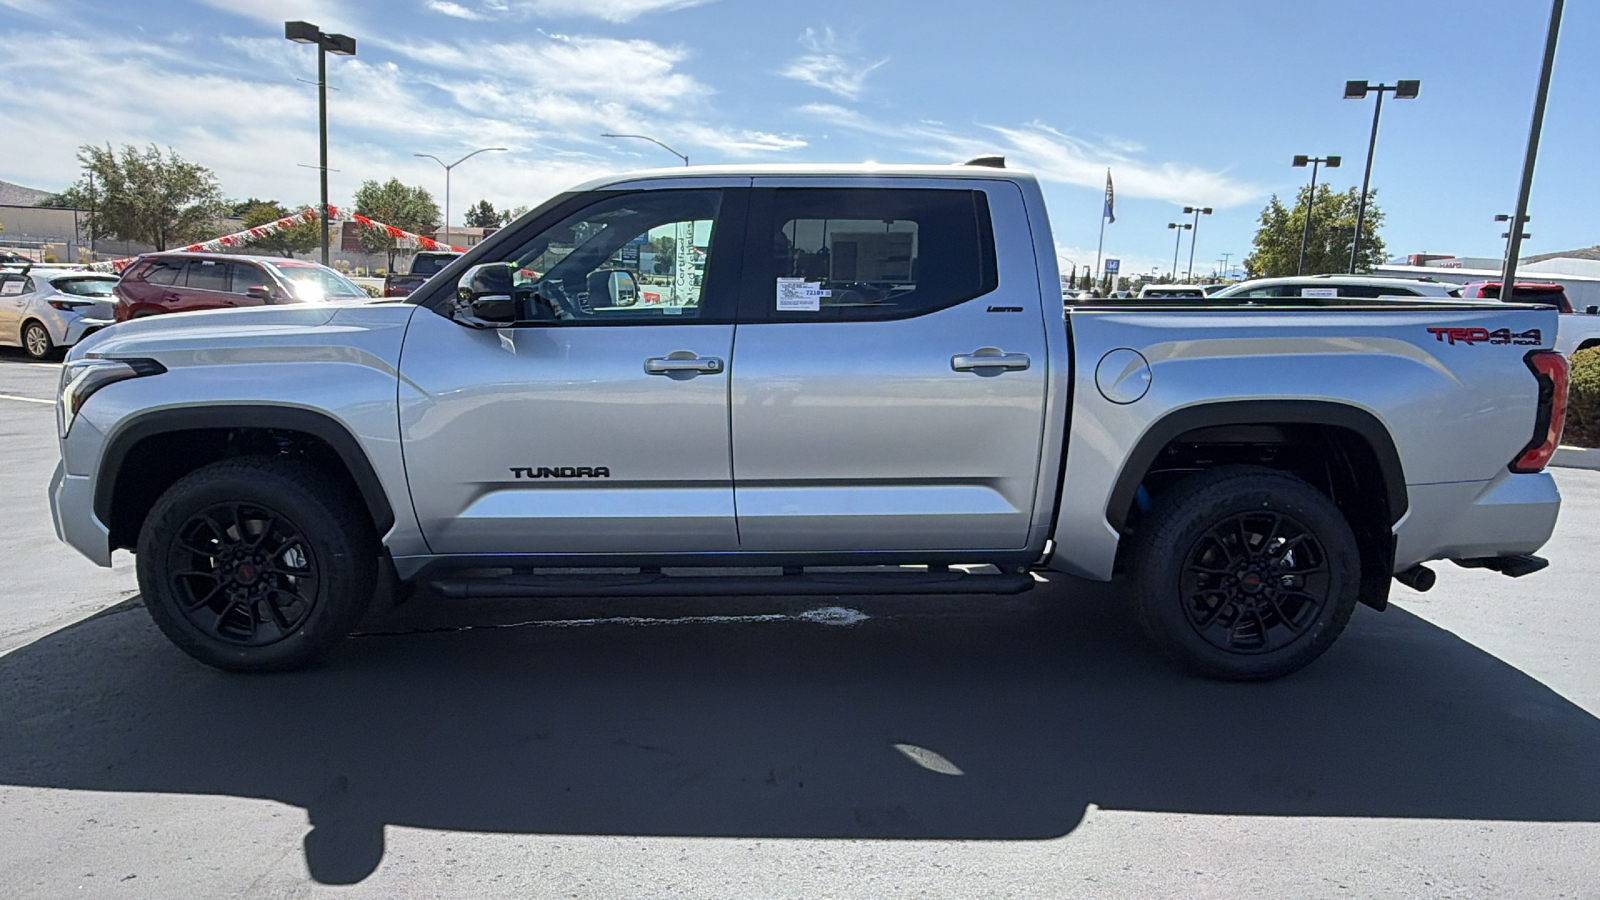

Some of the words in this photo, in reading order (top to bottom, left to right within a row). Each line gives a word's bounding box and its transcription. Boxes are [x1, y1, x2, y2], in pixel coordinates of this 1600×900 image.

[686, 224, 695, 270] Vehicles
[1426, 327, 1490, 345] TRD
[1490, 328, 1542, 341] 4x4
[509, 467, 610, 478] TUNDRA
